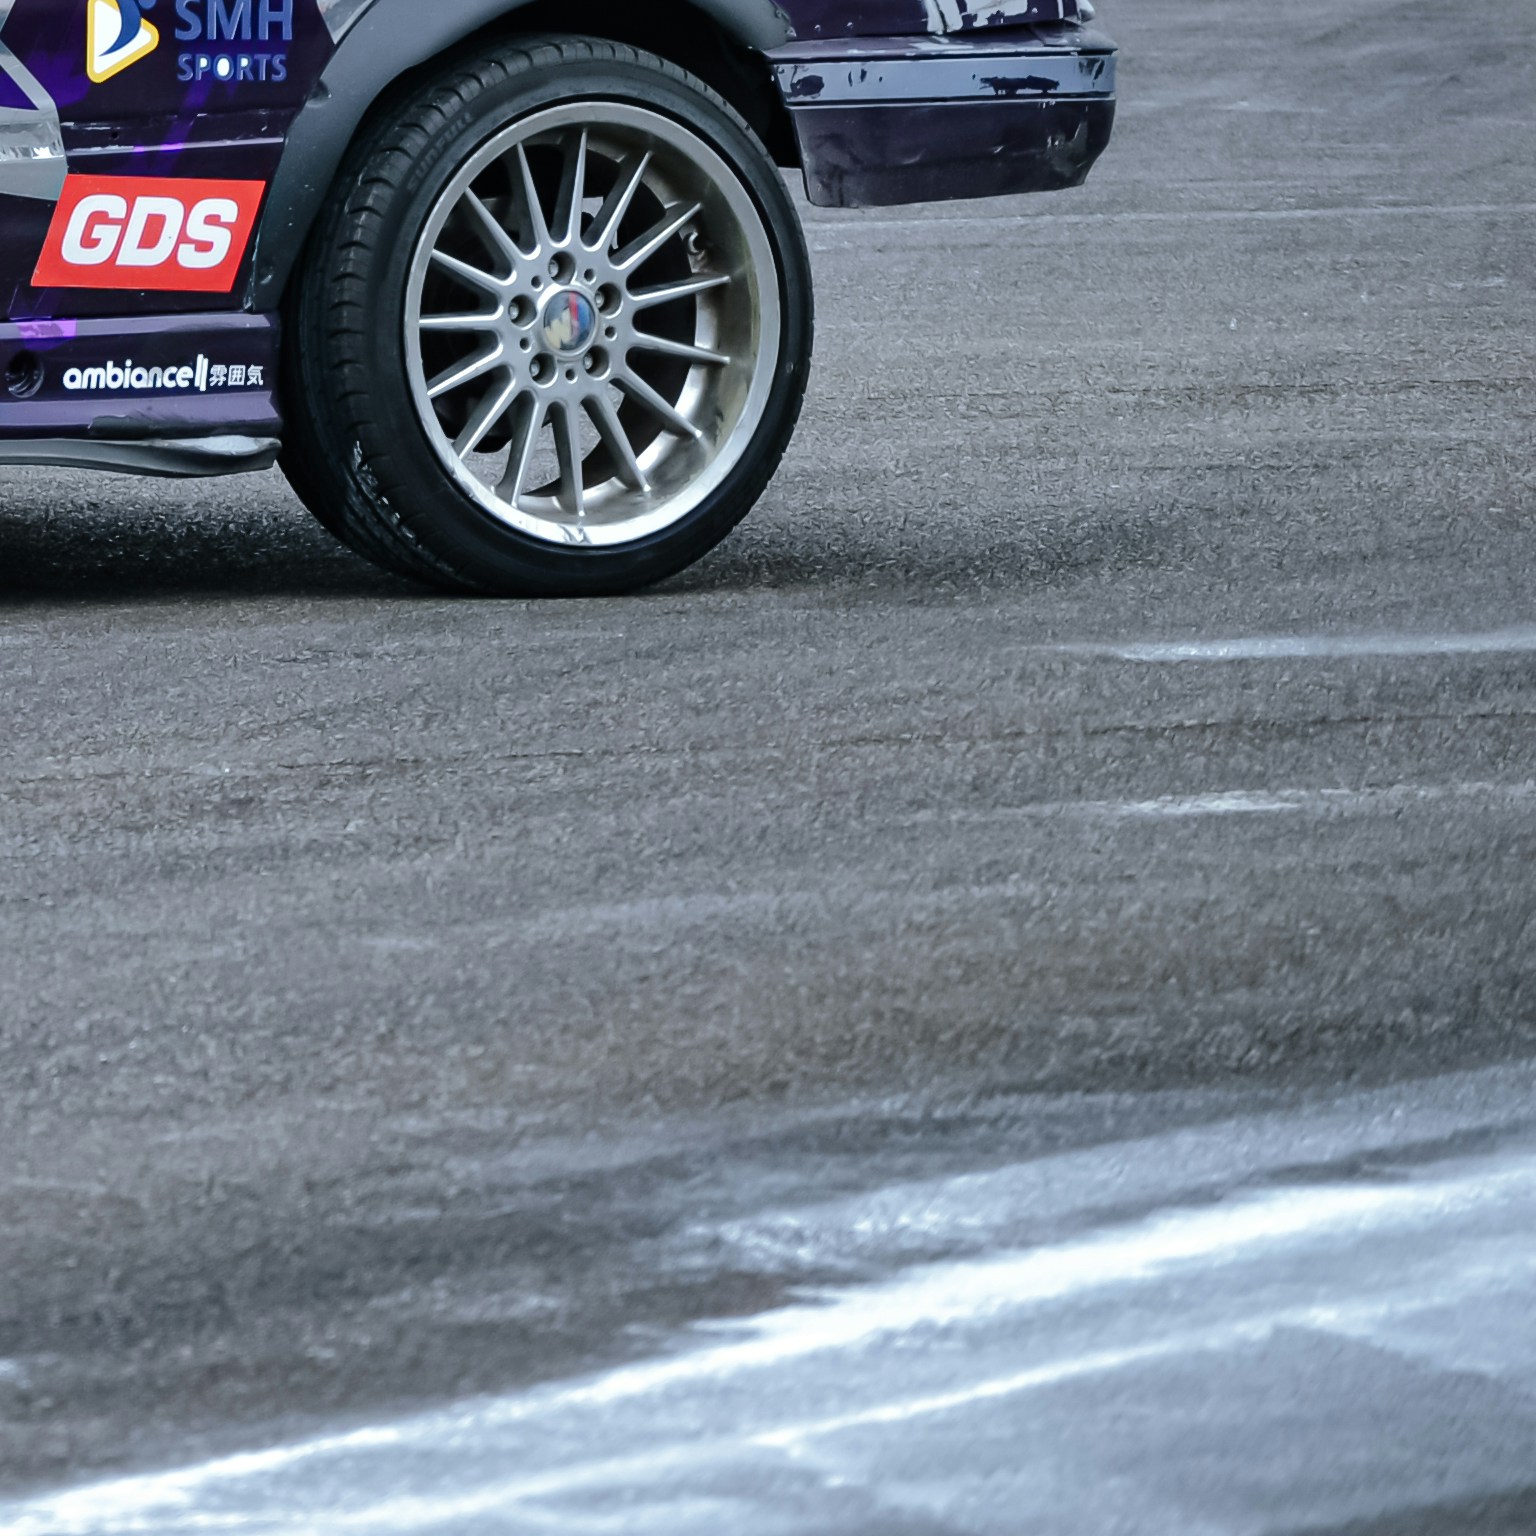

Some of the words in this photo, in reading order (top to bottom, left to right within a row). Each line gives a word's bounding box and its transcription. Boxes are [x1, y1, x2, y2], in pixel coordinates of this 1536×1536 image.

[176, 53, 287, 82] SPORTS
[61, 194, 239, 270] GDS
[62, 358, 194, 390] ambiance
